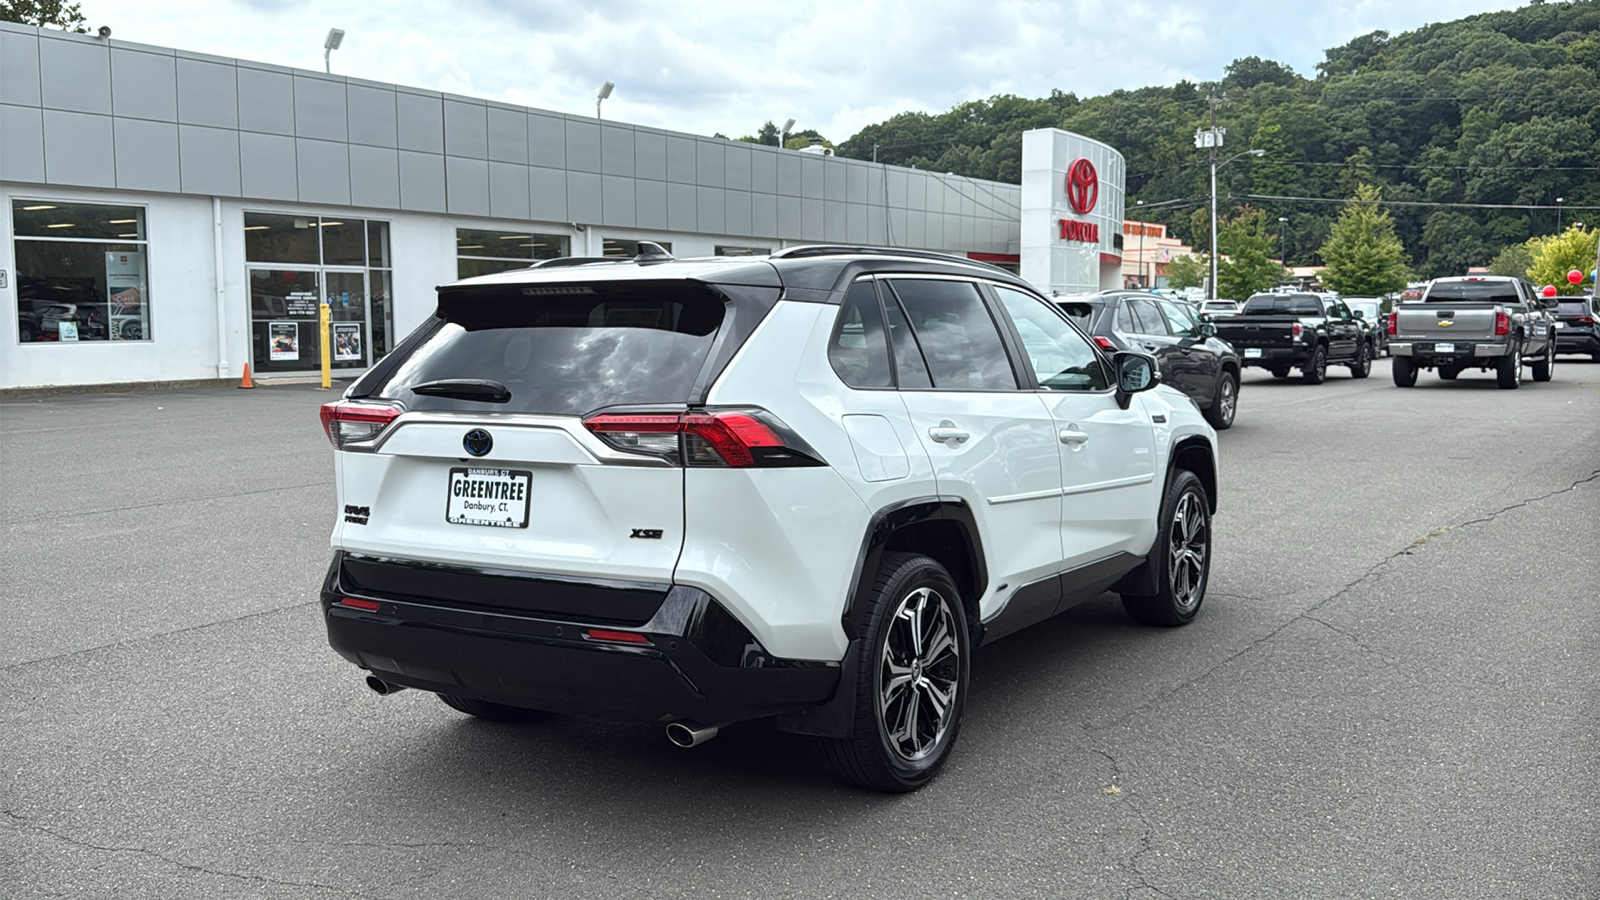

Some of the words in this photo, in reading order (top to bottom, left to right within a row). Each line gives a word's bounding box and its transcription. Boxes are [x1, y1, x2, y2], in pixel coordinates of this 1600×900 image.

[1059, 219, 1099, 243] TOYOTA
[453, 479, 524, 501] GREENTREE
[463, 500, 496, 513] Danbury,
[498, 502, 509, 512] CT.
[449, 517, 521, 527] GREENTREE
[629, 528, 664, 540] XSE
